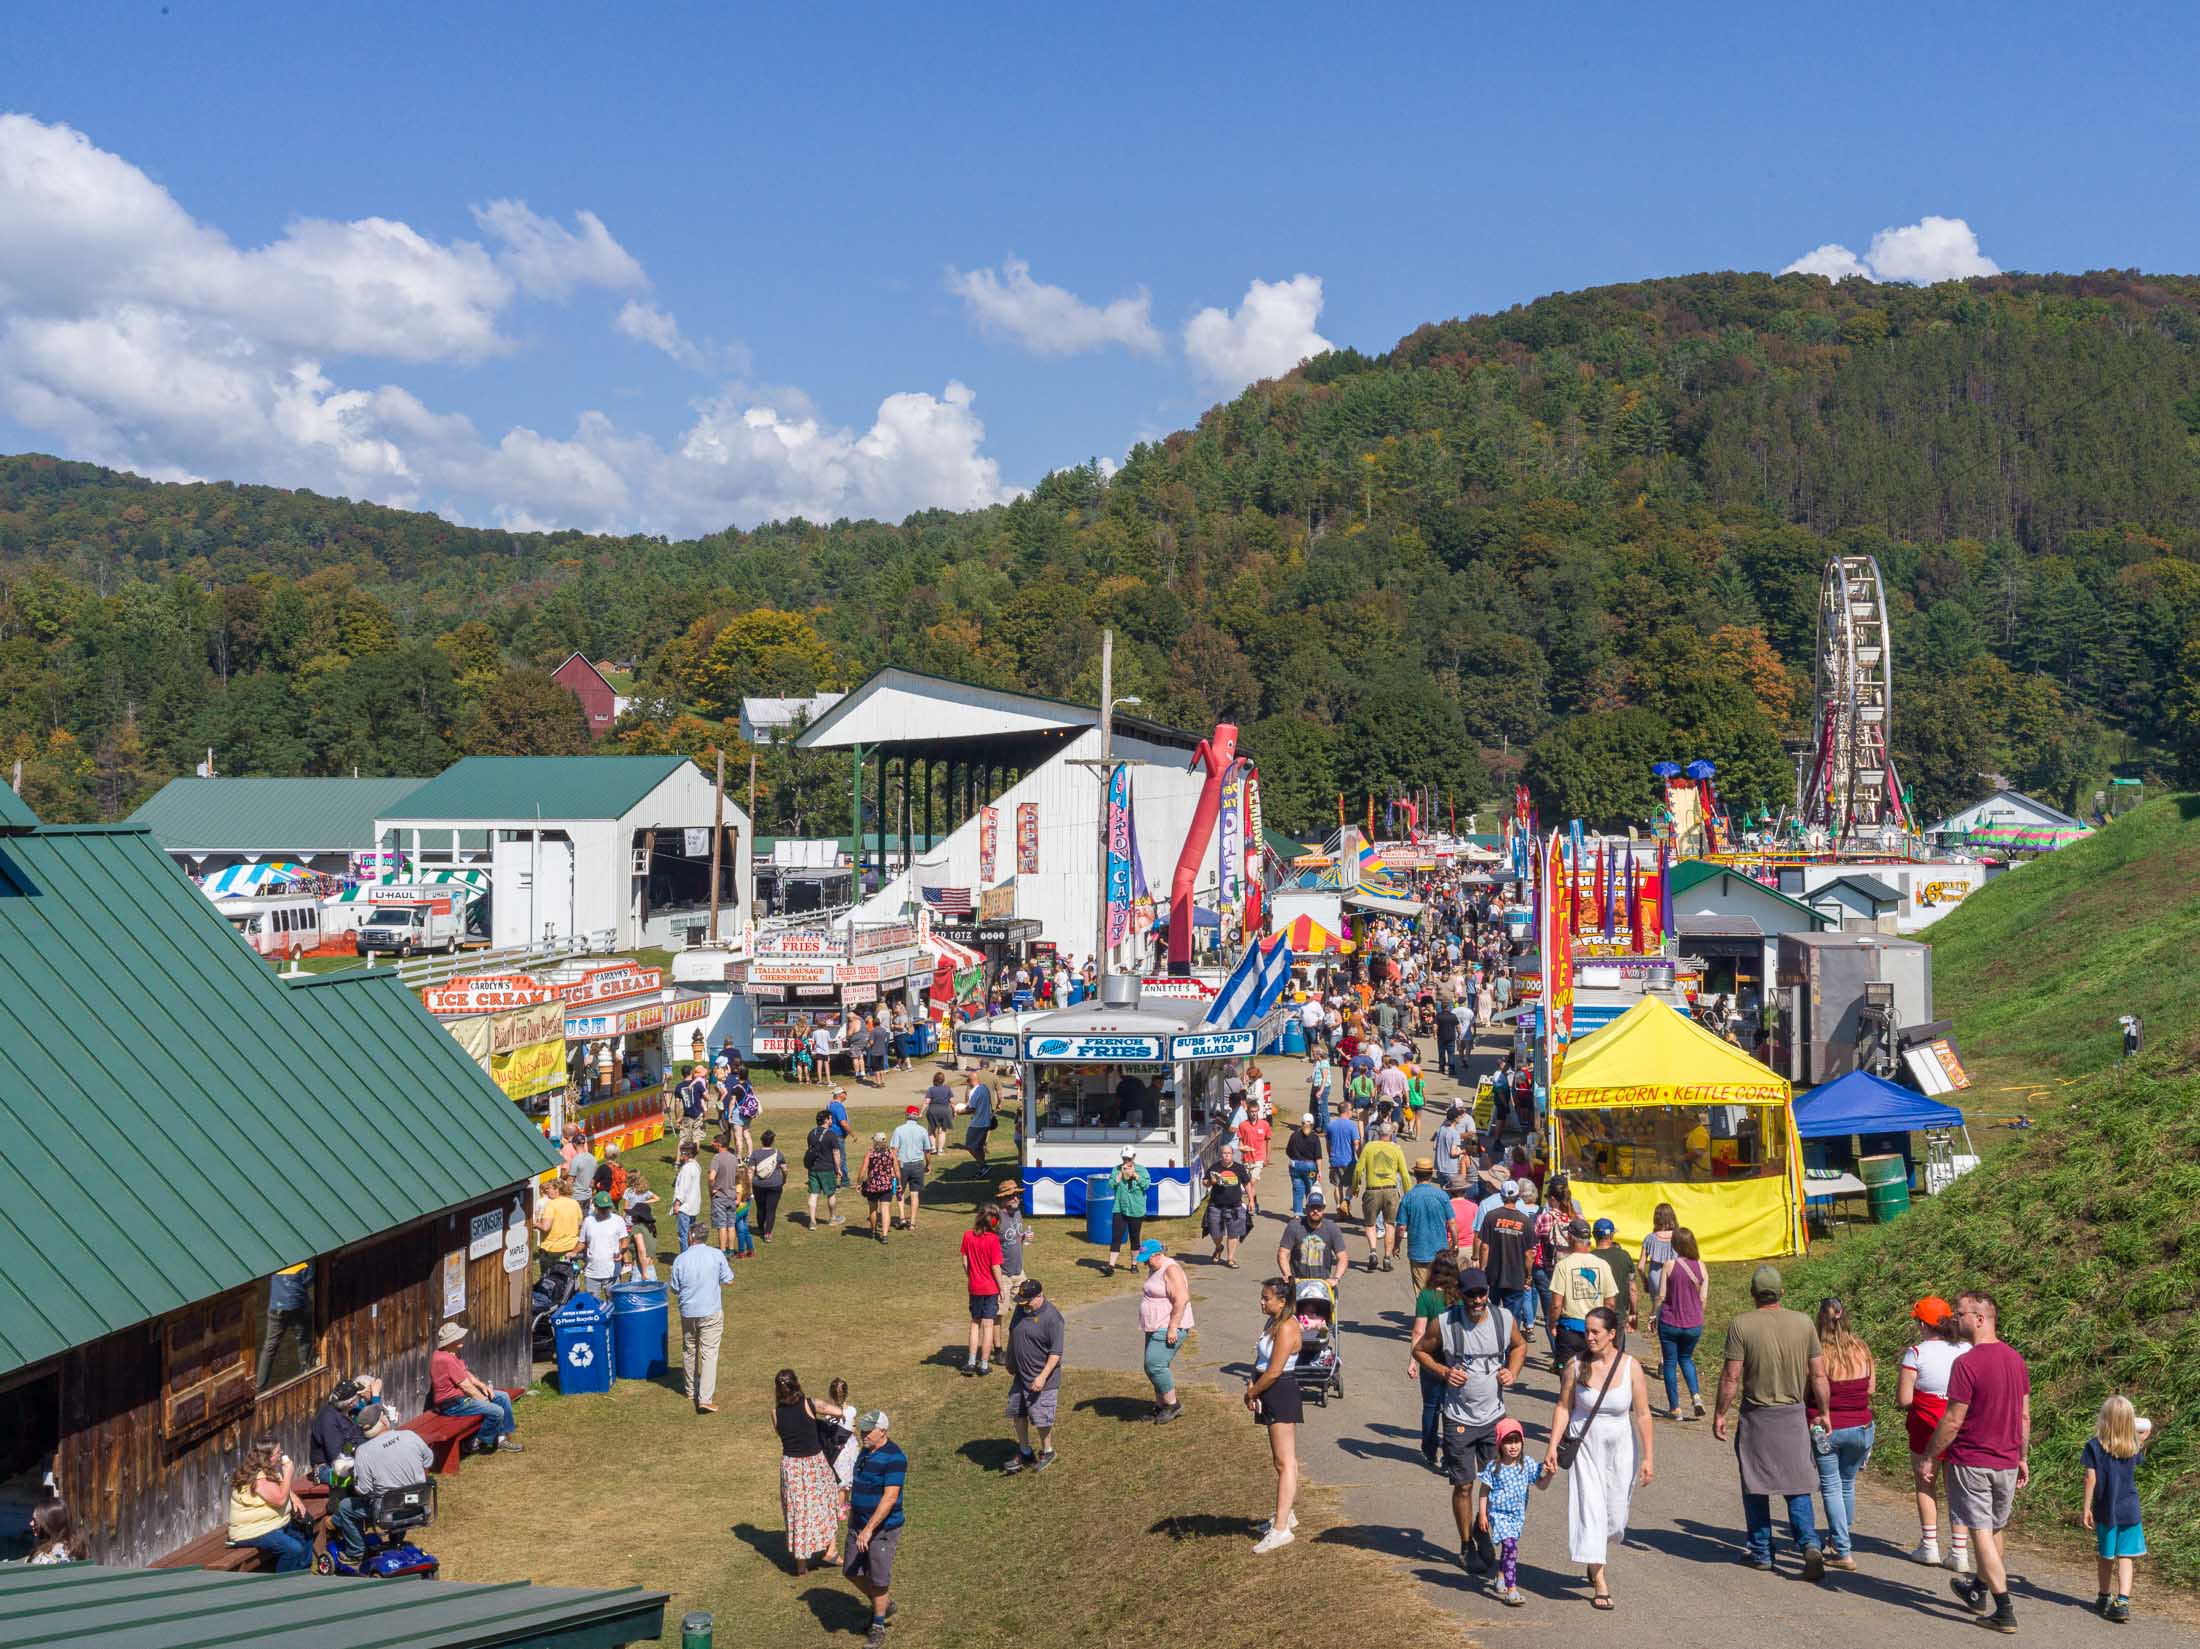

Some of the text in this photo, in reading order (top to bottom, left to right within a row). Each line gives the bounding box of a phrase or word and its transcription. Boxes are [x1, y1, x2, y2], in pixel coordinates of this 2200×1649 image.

[1112, 870, 1127, 940] CANDY
[950, 931, 972, 939] TOTZ
[783, 942, 820, 952] FRIES
[836, 967, 856, 976] CHICKEN
[760, 974, 819, 982] CHEESESTEAK
[470, 981, 511, 991] CAROLYN'S
[562, 973, 656, 1003] ICE CREAM
[843, 986, 875, 994] BURGERS
[436, 991, 545, 1007] ICE CREAM
[962, 1034, 1014, 1046] SUBS WRAPS
[1085, 1038, 1145, 1046] FRENCH
[1177, 1034, 1250, 1047] SUBS WRAPS
[973, 1044, 1003, 1055] SALADS
[1077, 1046, 1152, 1057] FRIES
[1192, 1045, 1234, 1056] SALADS
[1125, 1064, 1160, 1074] WRAPS
[1555, 1085, 1781, 1105] KETTLE CORN KETTLE CORN
[472, 1211, 503, 1237] SPONSOR
[509, 1244, 525, 1256] MAPLE
[382, 1436, 400, 1449] NAVY
